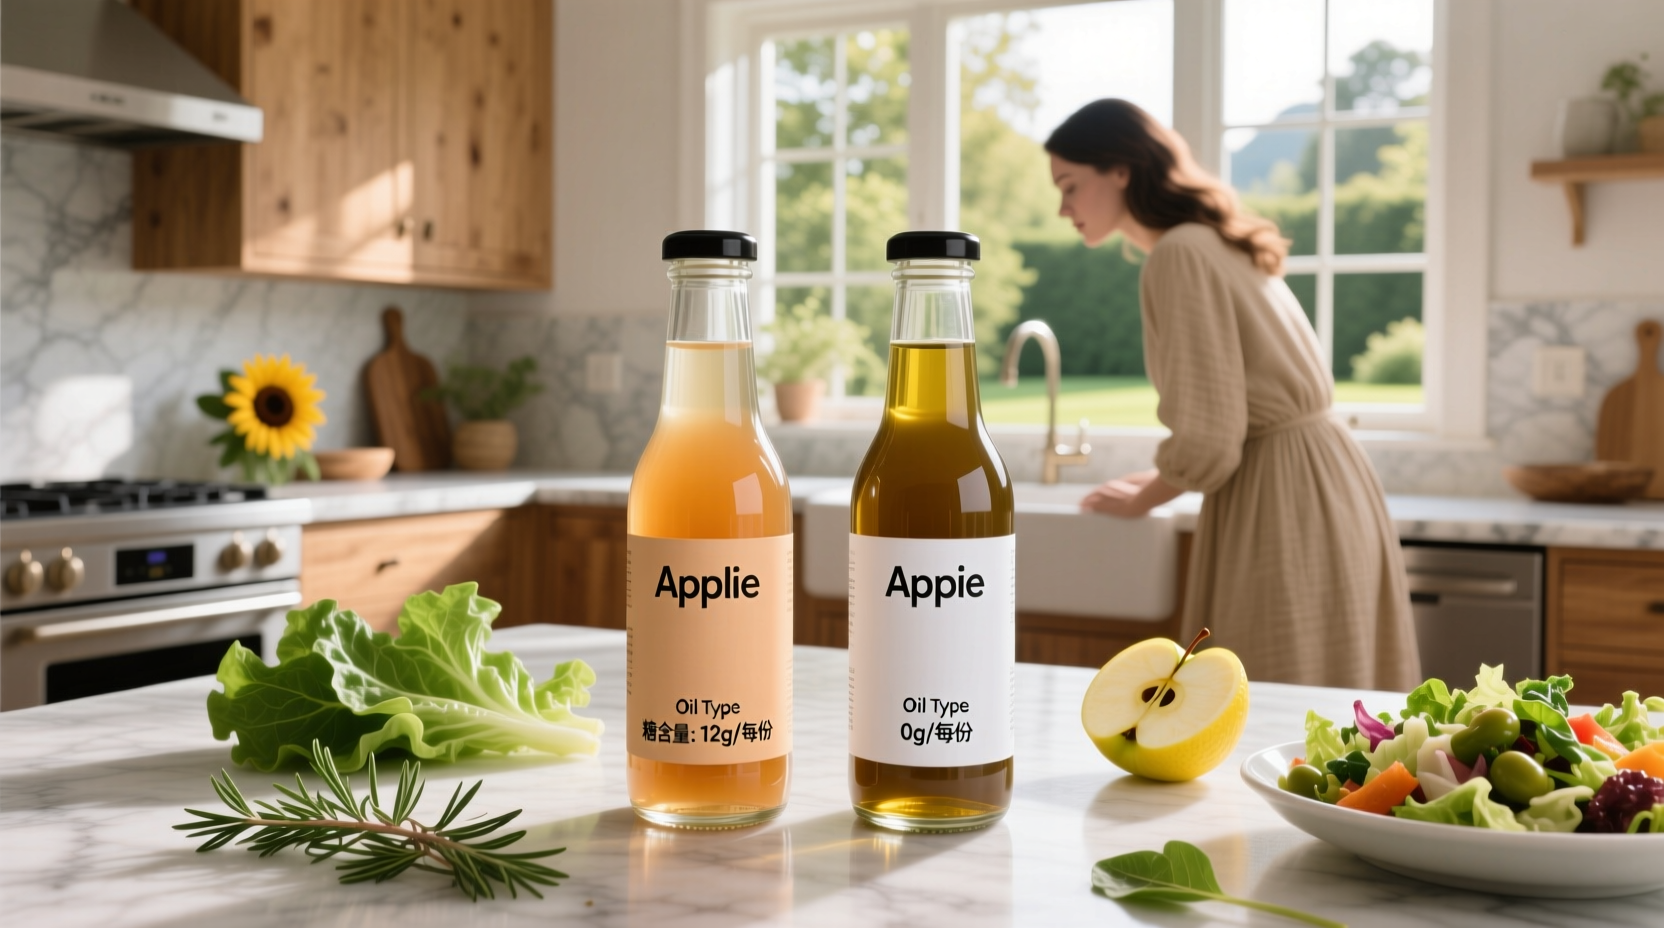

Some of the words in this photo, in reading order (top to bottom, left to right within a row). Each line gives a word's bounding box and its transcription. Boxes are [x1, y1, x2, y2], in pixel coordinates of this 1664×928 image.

[655, 565, 760, 608] Applie
[885, 565, 985, 607] Appie
[676, 698, 698, 715] Oil
[701, 699, 741, 719] Type
[903, 697, 926, 713] Oil
[930, 698, 970, 718] Type
[900, 721, 973, 746] 0g/每份
